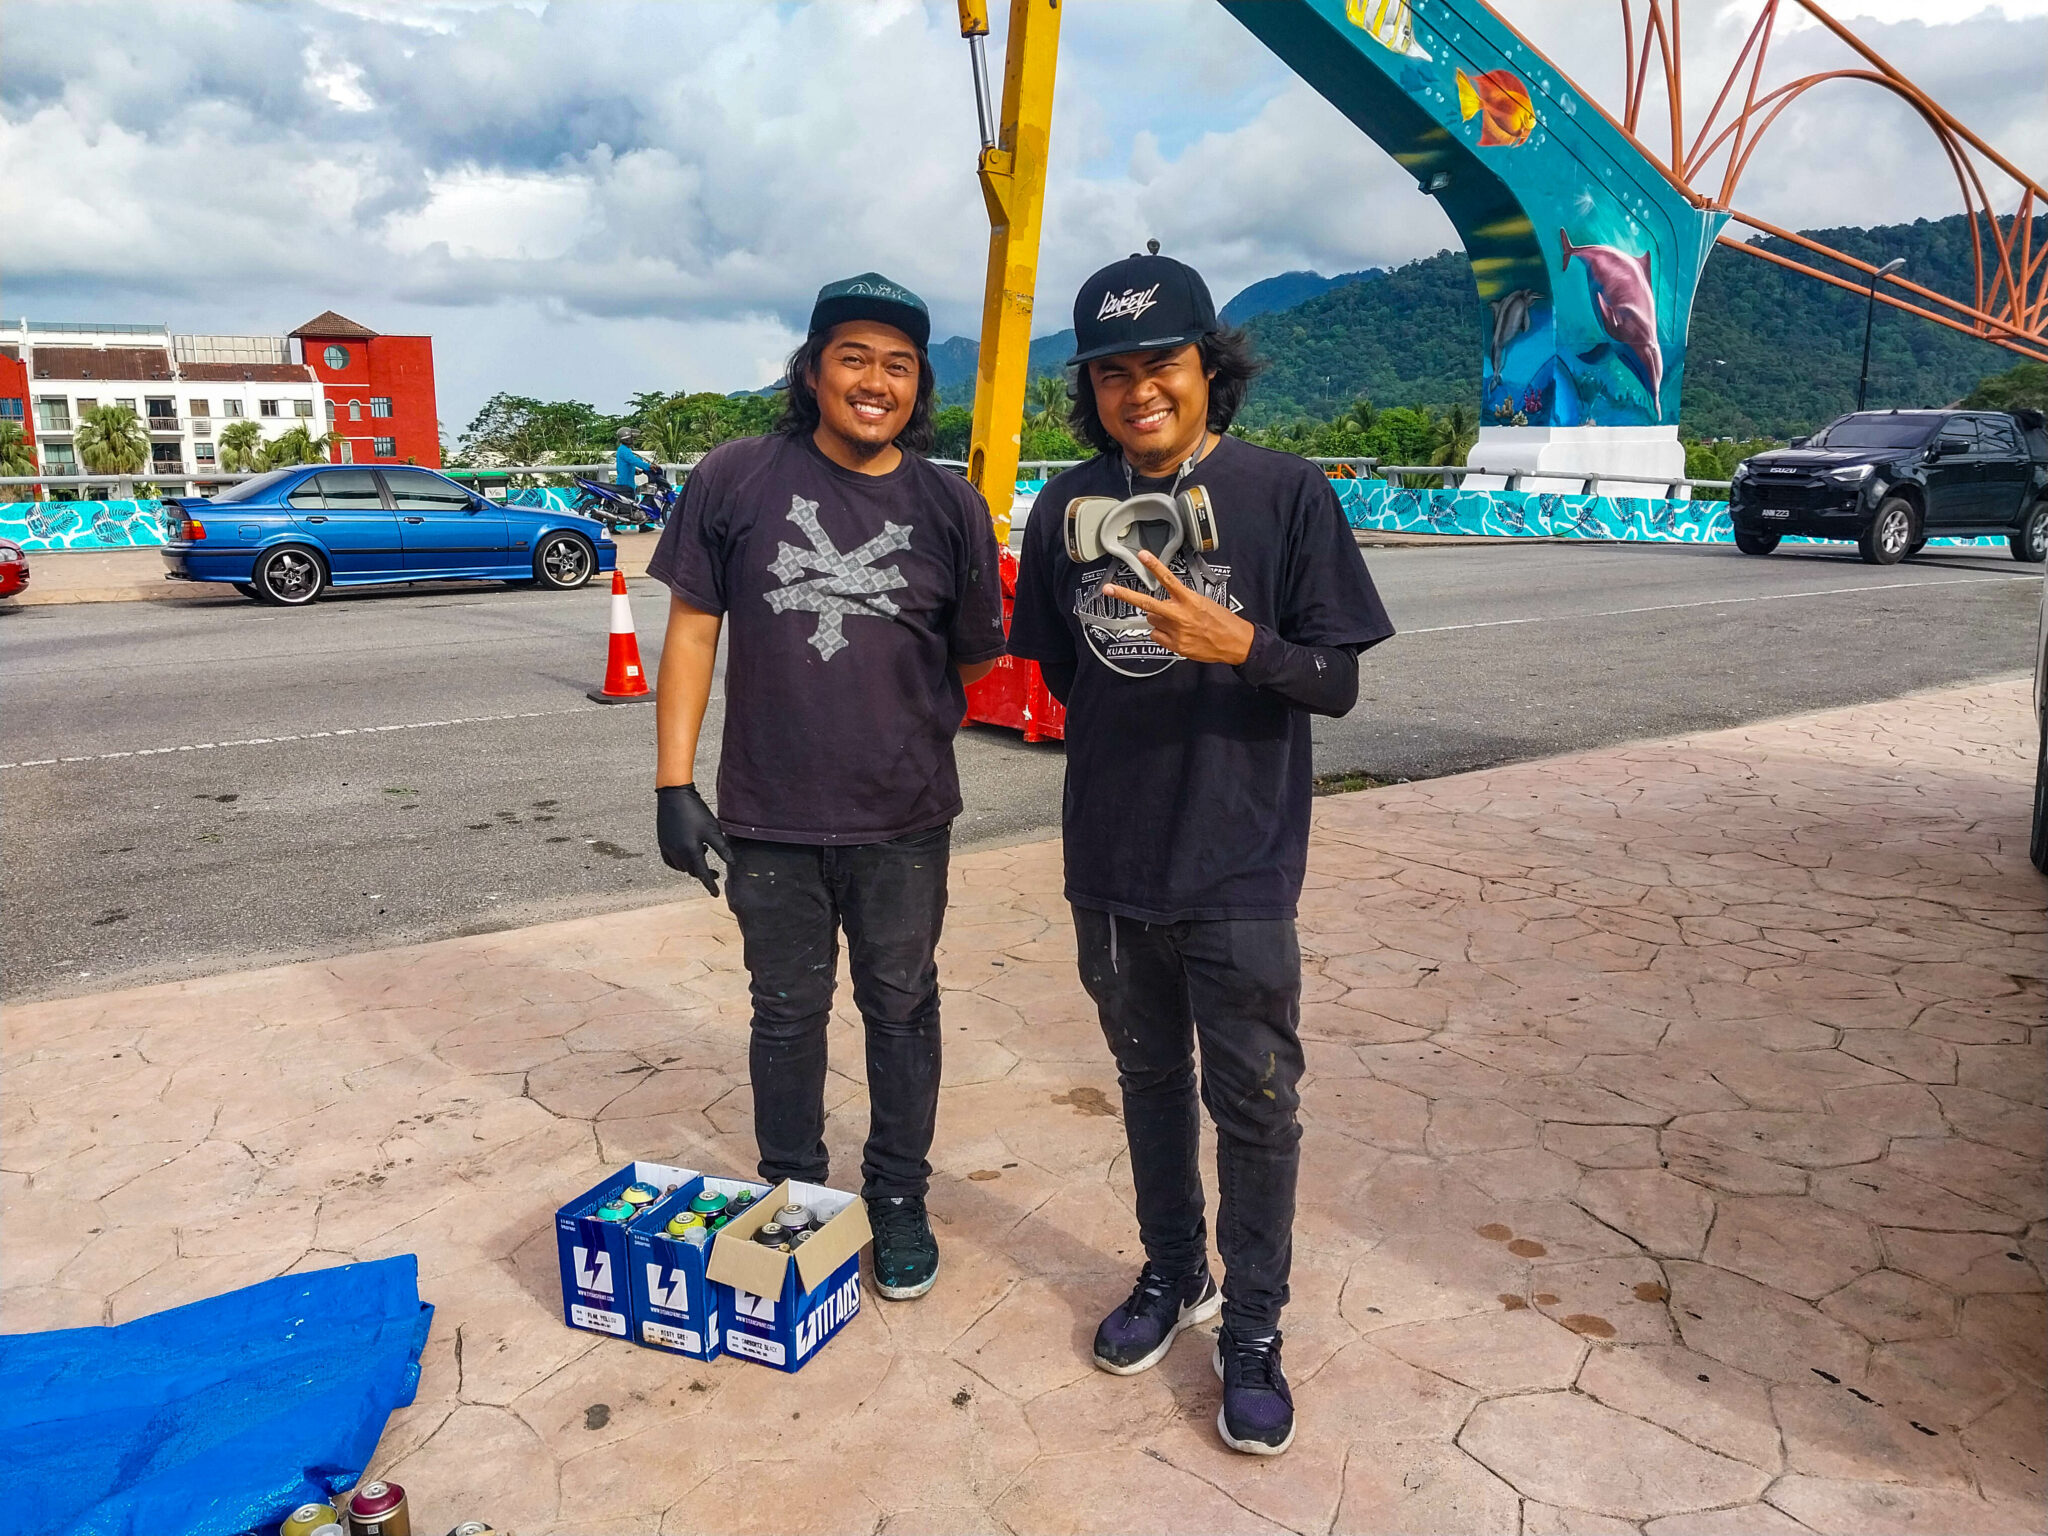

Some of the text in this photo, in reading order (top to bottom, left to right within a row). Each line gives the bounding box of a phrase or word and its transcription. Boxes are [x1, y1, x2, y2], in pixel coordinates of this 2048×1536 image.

[1775, 509, 1790, 518] 223
[1106, 646, 1138, 656] KUALA
[815, 1271, 860, 1341] TITANS
